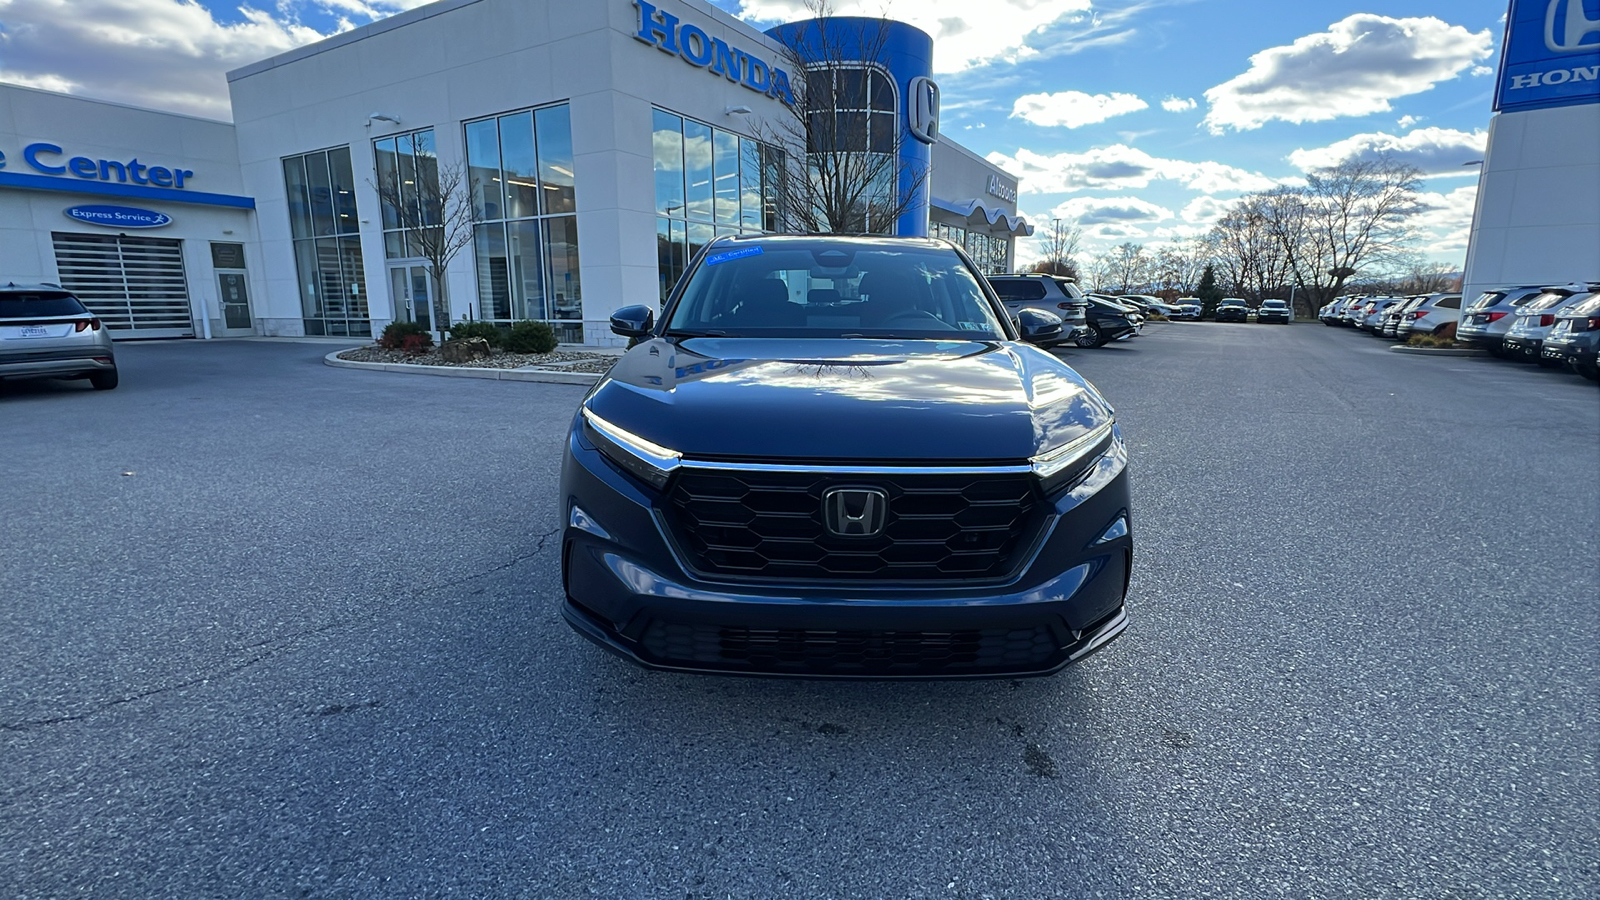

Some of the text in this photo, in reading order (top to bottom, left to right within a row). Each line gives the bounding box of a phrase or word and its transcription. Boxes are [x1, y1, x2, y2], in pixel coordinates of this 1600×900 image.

[634, 0, 797, 106] HONDA
[1510, 65, 1600, 90] HON
[23, 142, 194, 188] Center
[72, 208, 152, 223] Express Service
